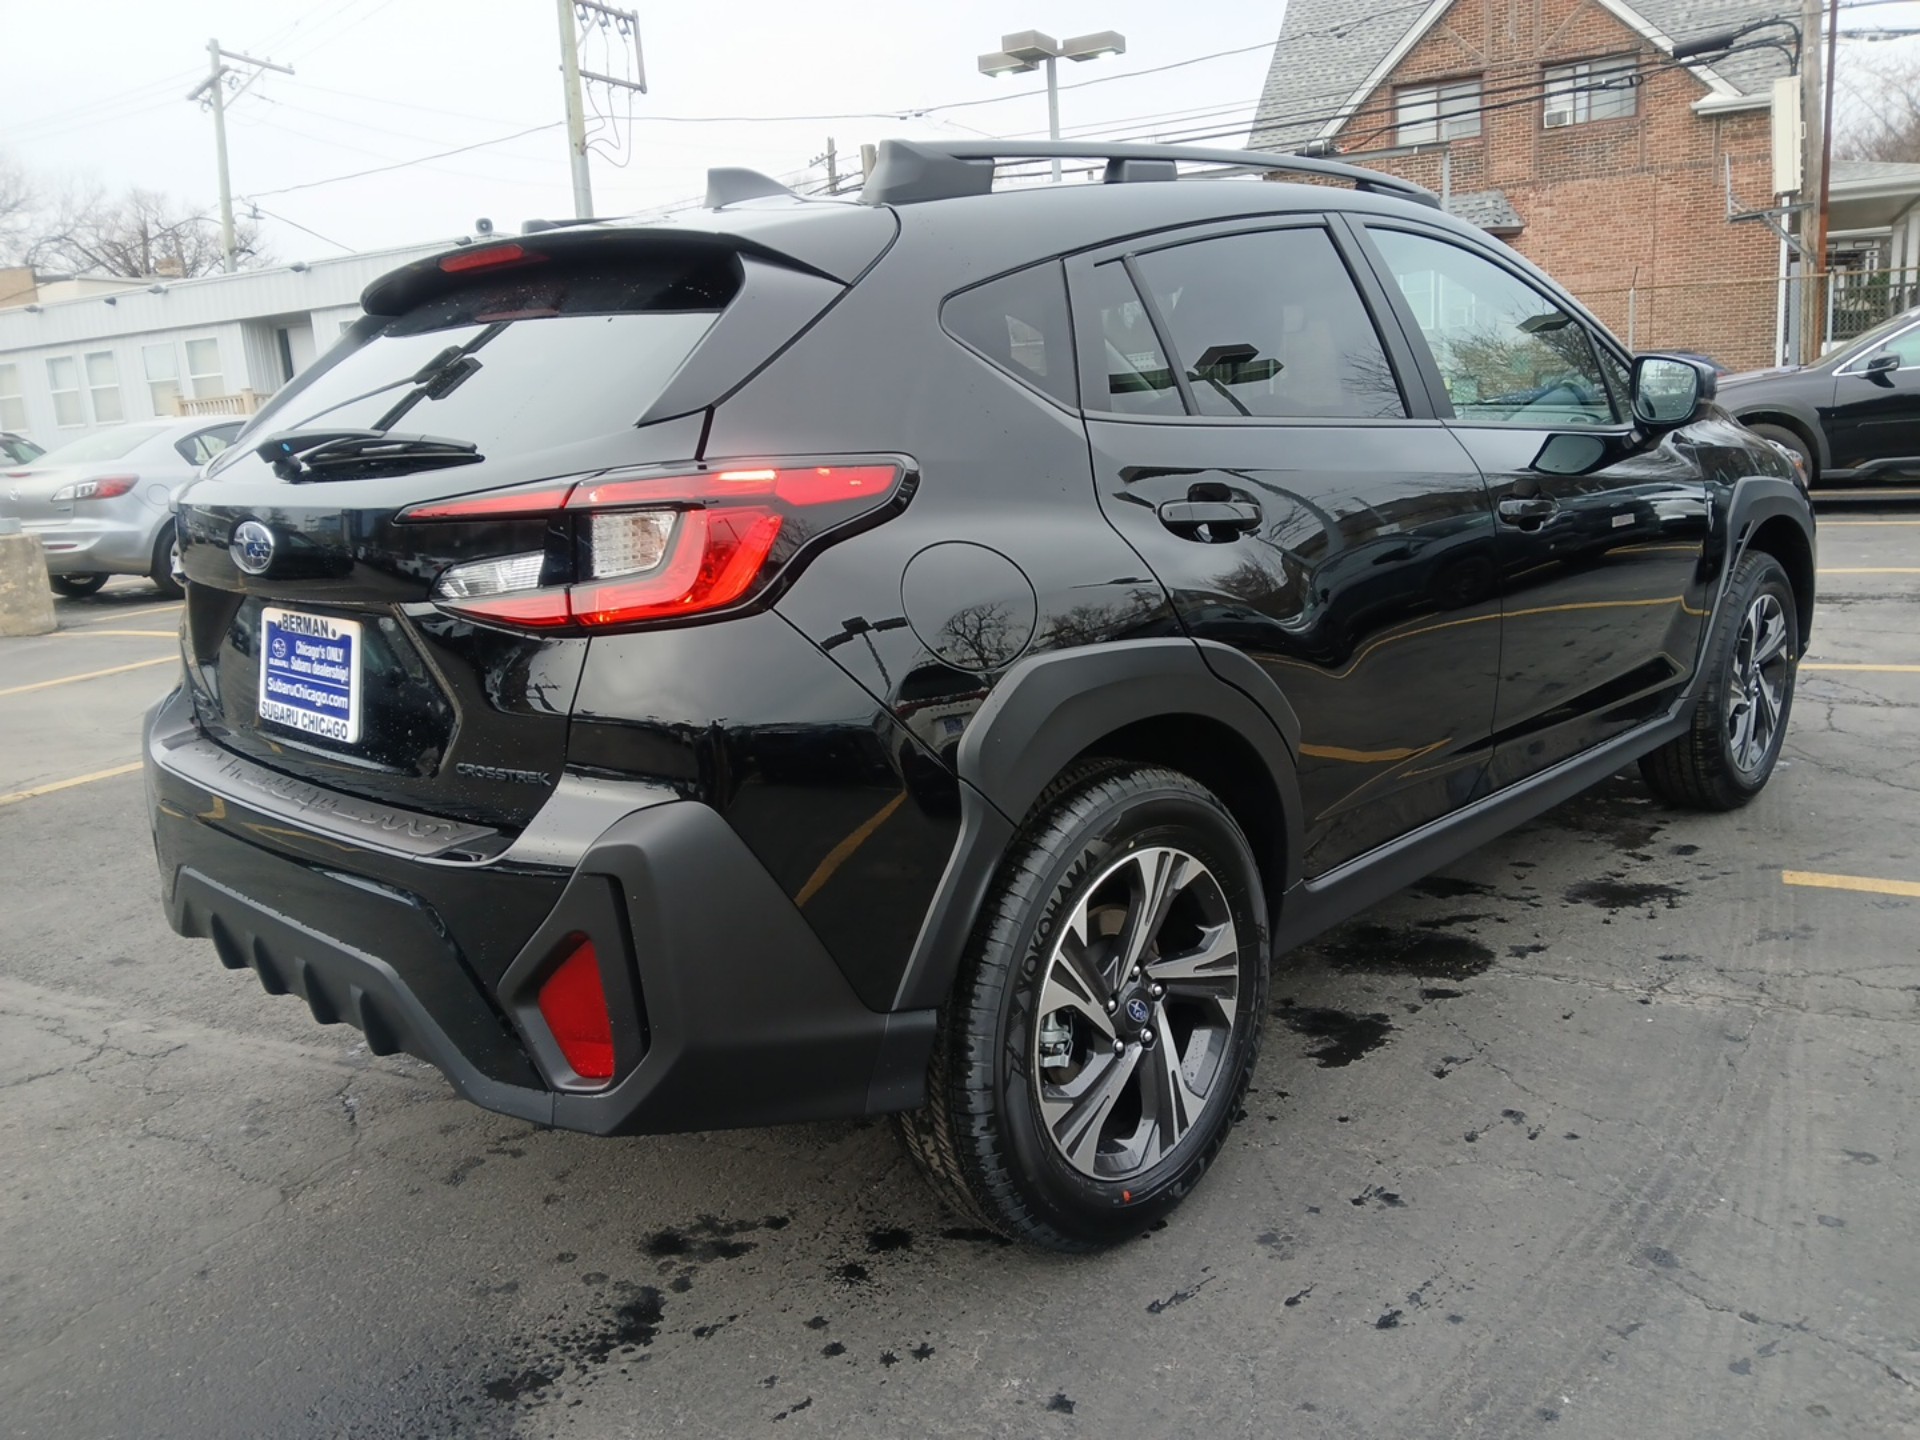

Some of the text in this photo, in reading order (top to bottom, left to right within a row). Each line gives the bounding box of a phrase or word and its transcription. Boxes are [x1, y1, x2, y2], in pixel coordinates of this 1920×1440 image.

[281, 613, 329, 638] BERMAN
[295, 640, 344, 662] Chicago's ONLY
[290, 656, 349, 683] Subaru dealership!
[267, 677, 348, 709] SubaruChicago.com
[260, 700, 348, 740] SUBARU CHICAGO
[455, 762, 552, 786] CROSSTREK
[1015, 848, 1099, 994] YOKOHAMA
